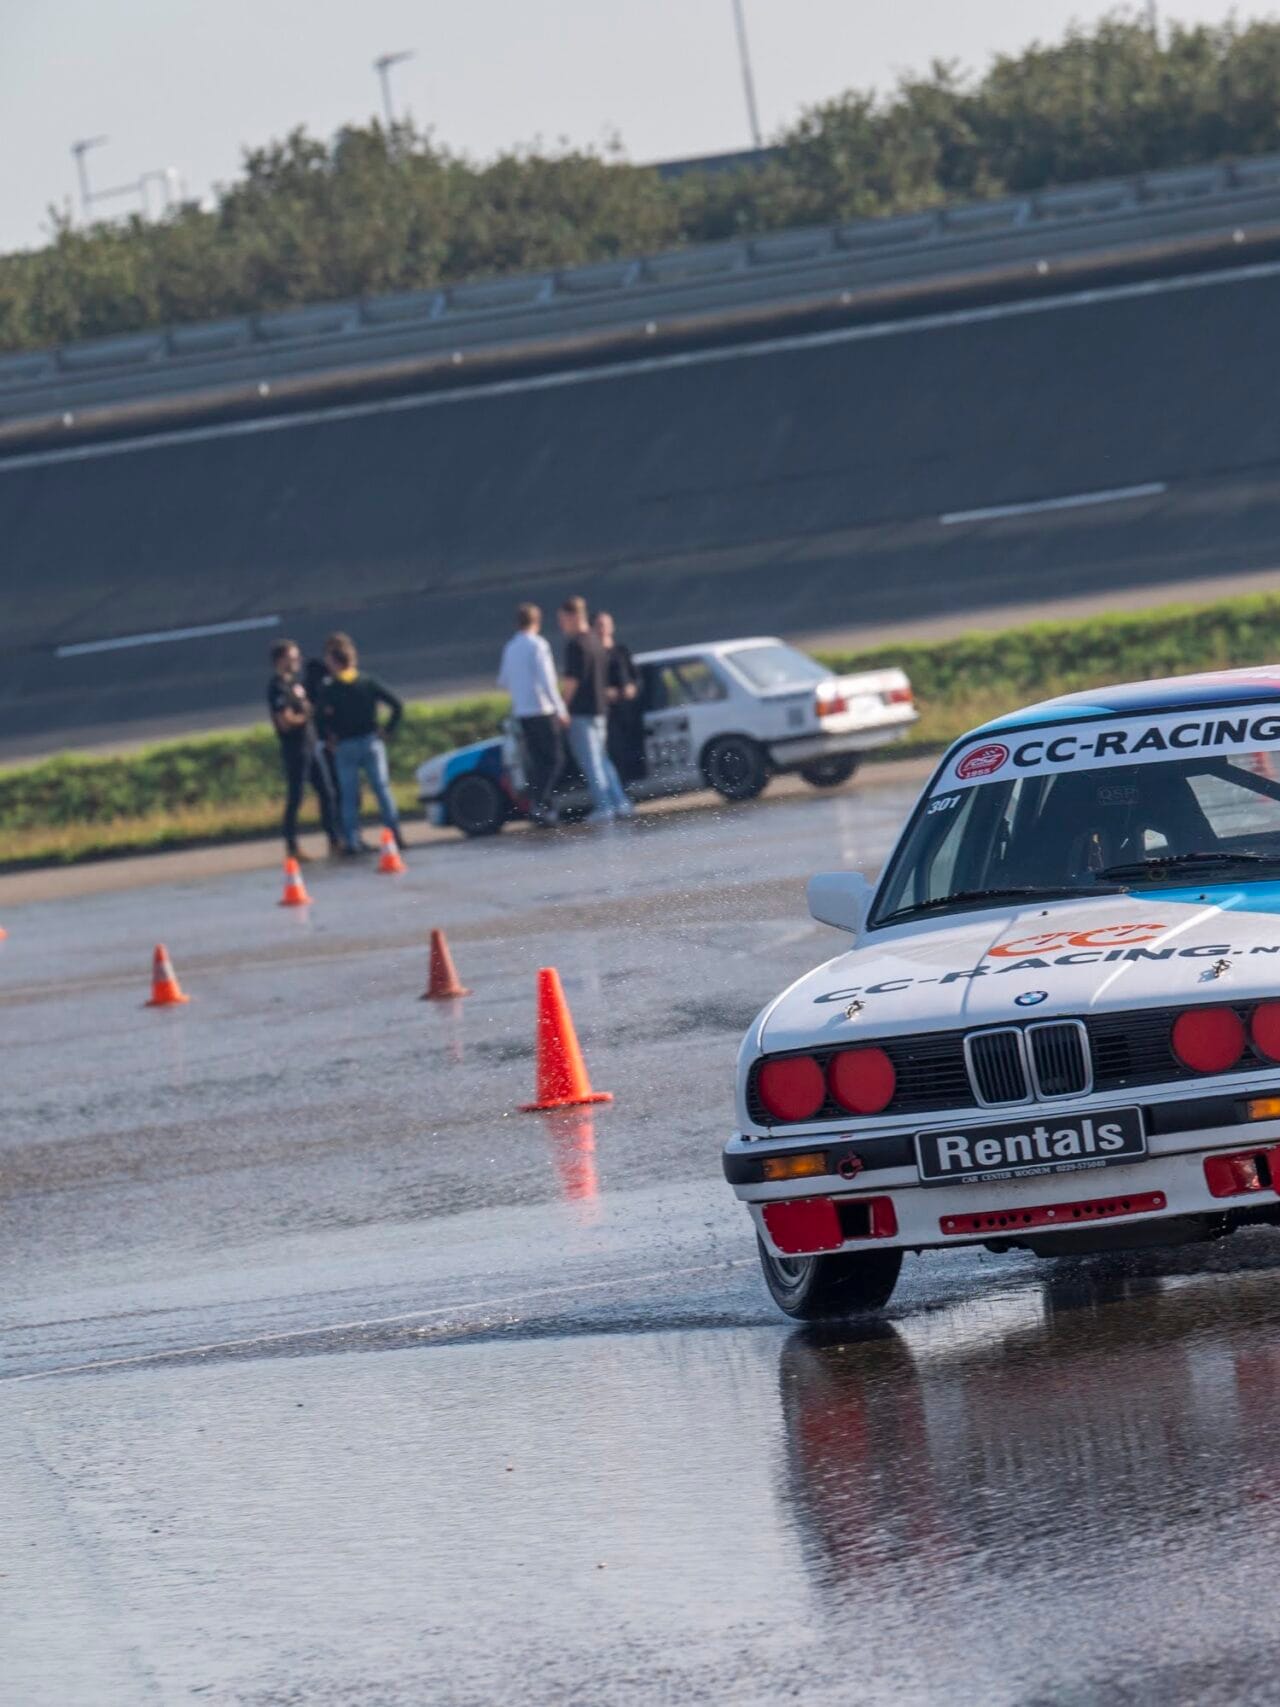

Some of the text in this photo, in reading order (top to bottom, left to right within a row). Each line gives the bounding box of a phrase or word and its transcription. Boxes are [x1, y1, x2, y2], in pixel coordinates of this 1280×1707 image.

[927, 794, 962, 815] 301
[936, 1119, 1125, 1170] Rentals
[961, 1174, 979, 1184] CAR
[982, 1170, 1012, 1181] CENTER
